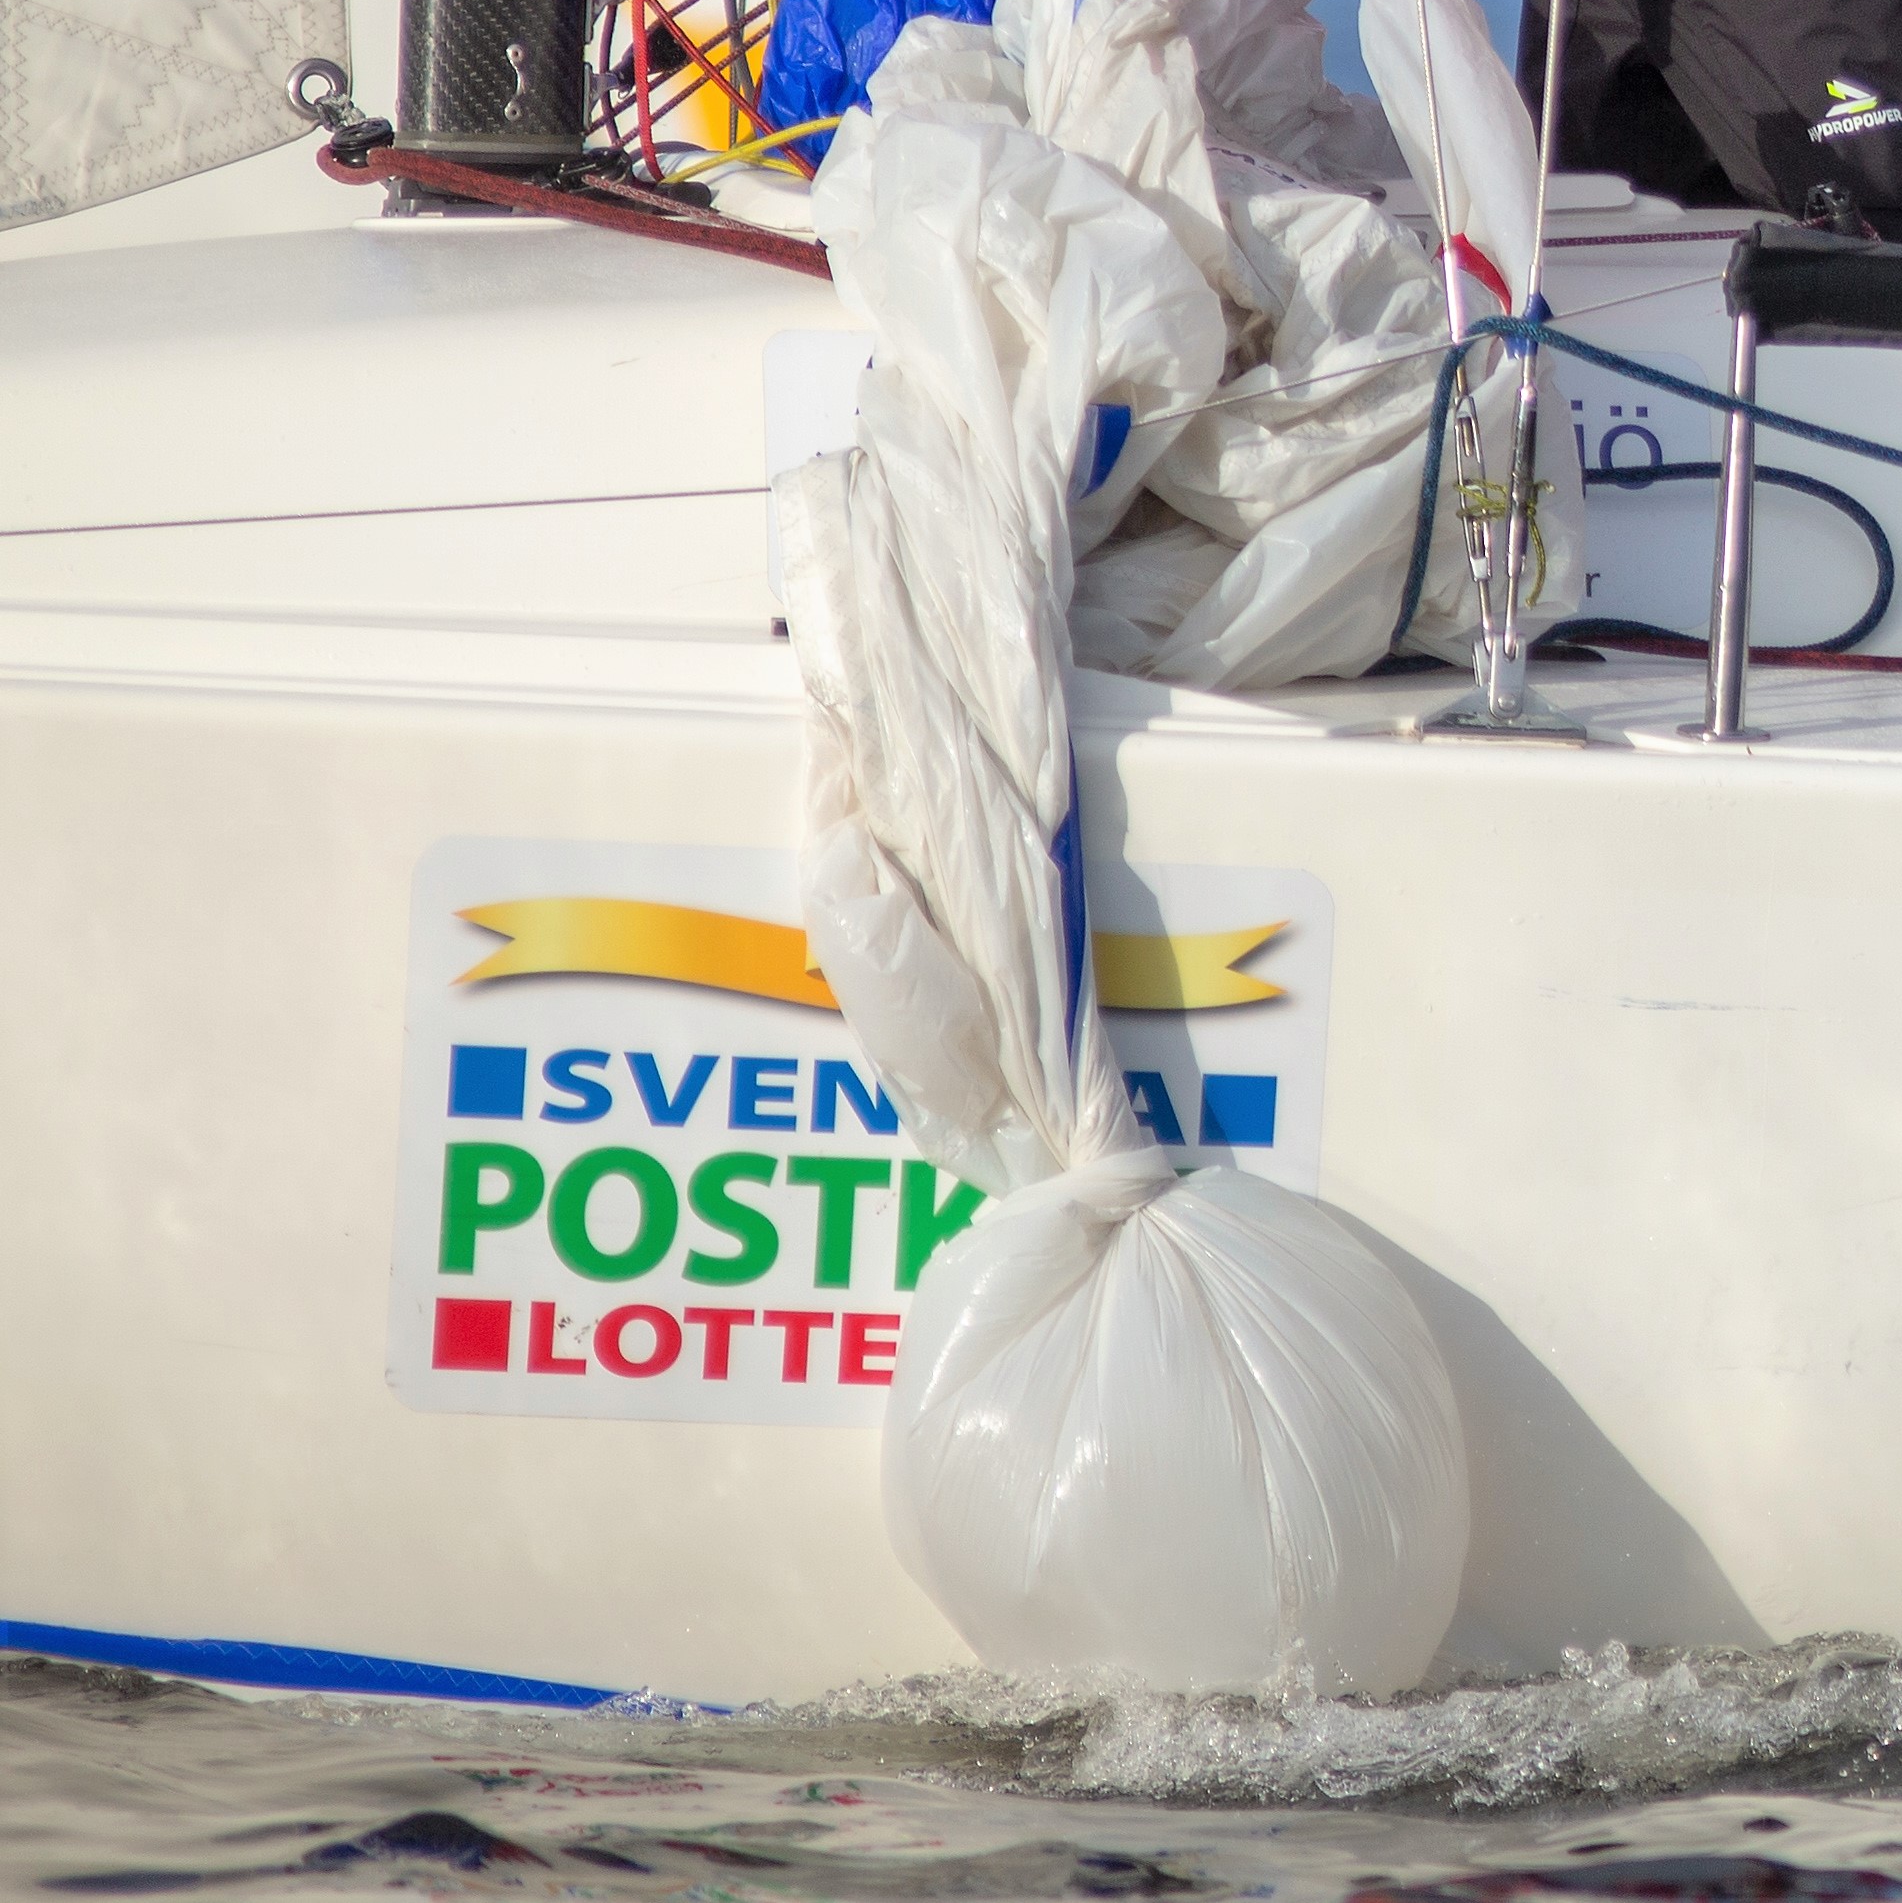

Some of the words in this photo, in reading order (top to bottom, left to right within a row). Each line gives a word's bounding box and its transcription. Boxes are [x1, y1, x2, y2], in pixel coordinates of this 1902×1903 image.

[538, 1046, 1188, 1147] SVENA
[437, 1141, 990, 1292] POSTK
[526, 1299, 902, 1386] LOTTE
